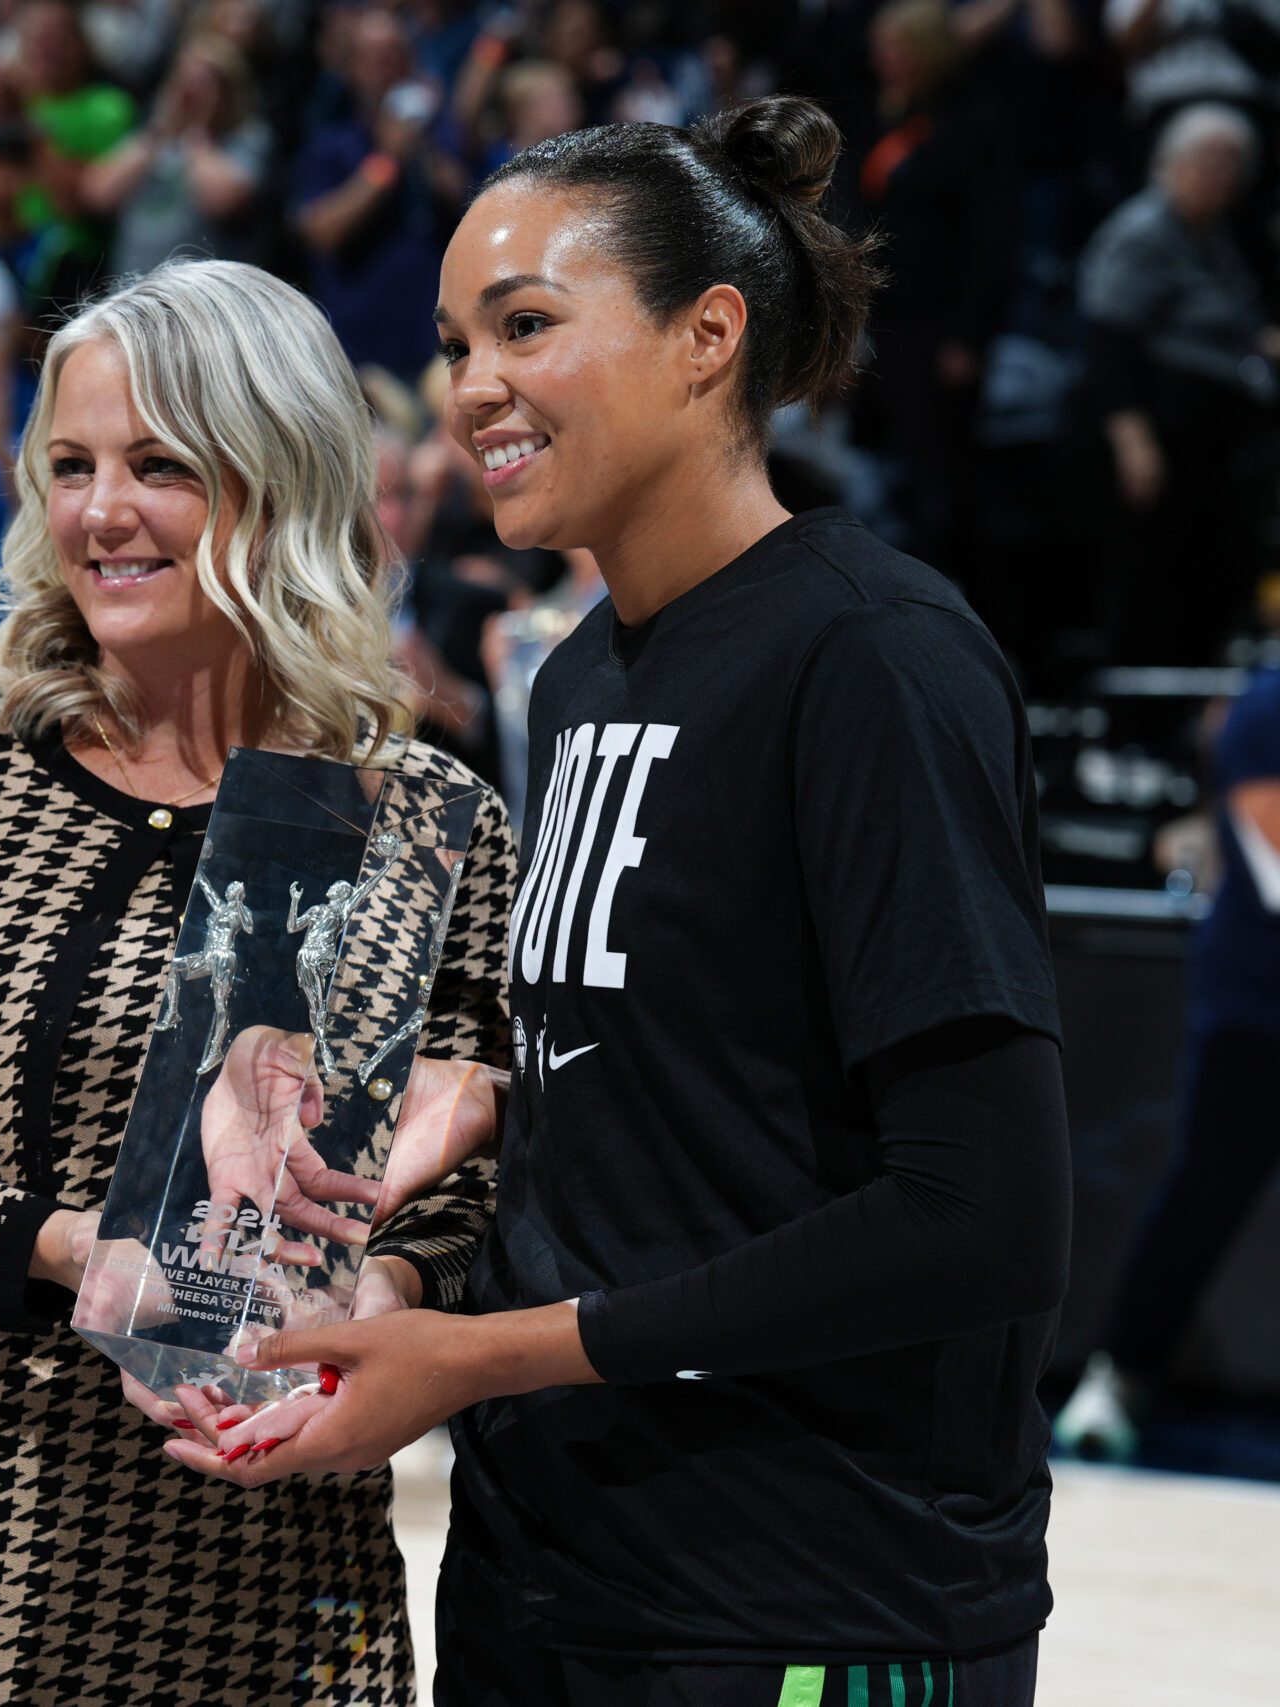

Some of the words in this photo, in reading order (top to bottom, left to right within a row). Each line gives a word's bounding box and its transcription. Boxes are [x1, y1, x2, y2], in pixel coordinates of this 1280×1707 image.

[508, 723, 680, 988] VOTE
[192, 1200, 282, 1231] 2024
[162, 1243, 288, 1287] WNBA
[187, 1272, 240, 1292] PLAYER
[242, 1282, 263, 1295] OF
[157, 1302, 229, 1324] Minnesota
[221, 1297, 282, 1318] COLLIER
